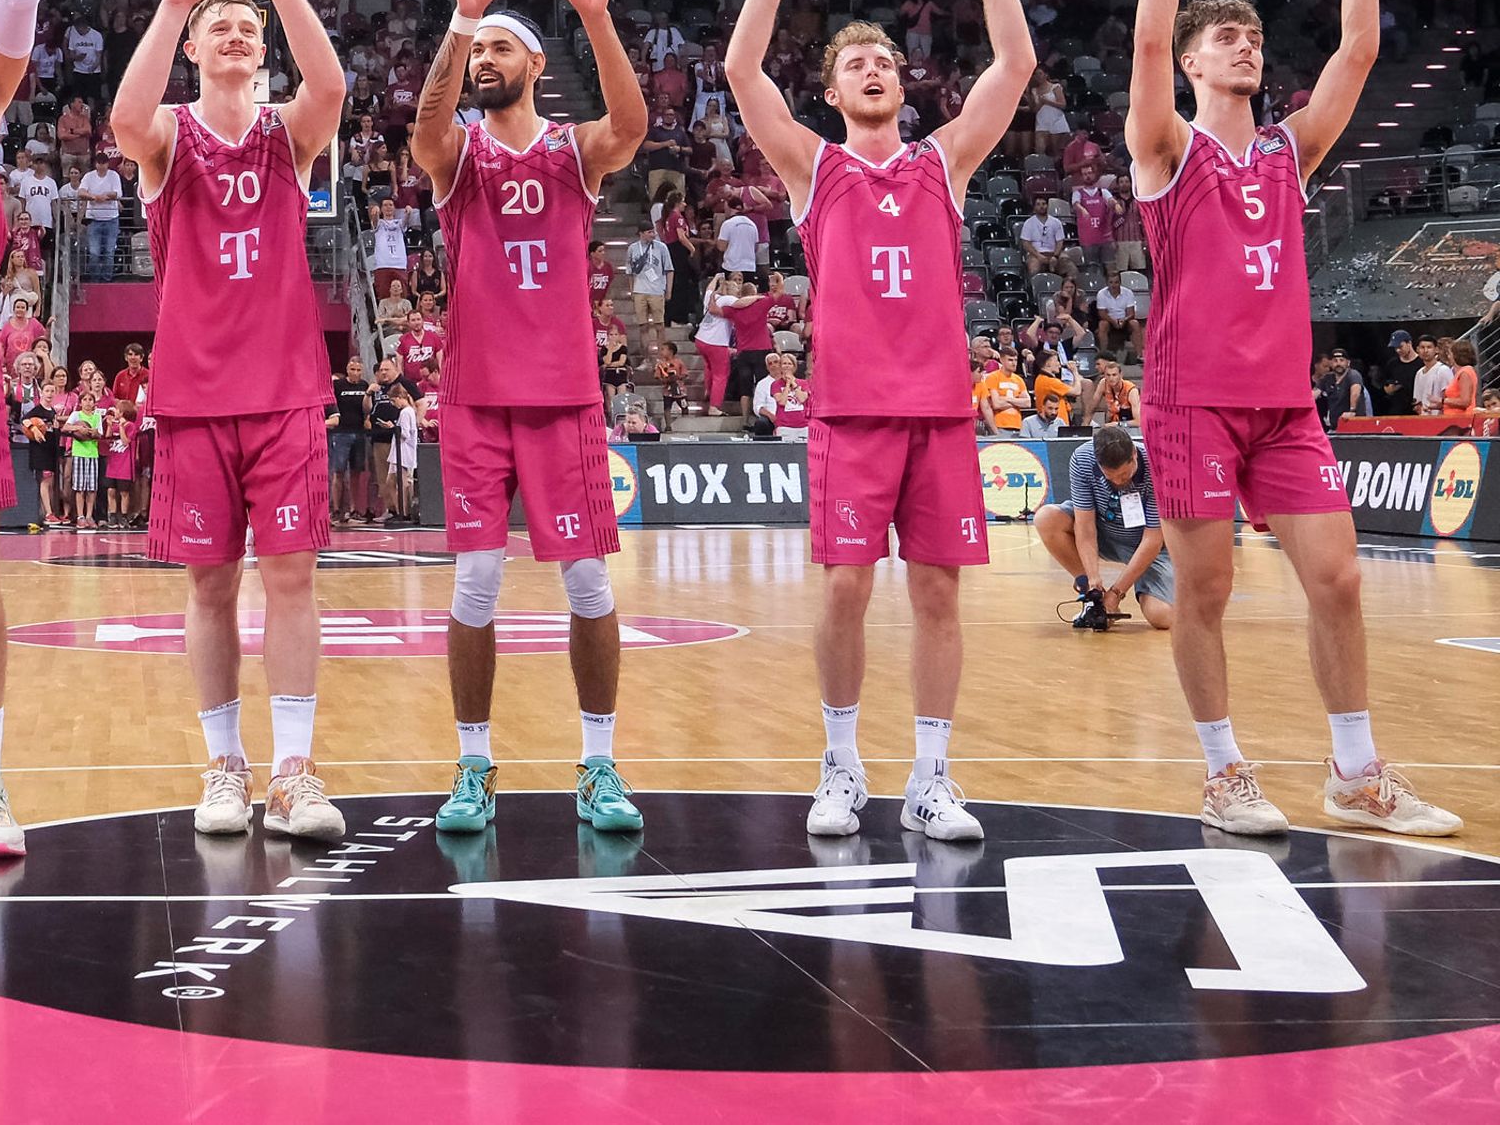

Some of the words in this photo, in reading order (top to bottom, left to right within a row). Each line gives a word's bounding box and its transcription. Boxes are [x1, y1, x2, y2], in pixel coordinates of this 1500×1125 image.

[30, 187, 50, 197] GAP
[217, 170, 262, 207] 70
[501, 179, 545, 215] 20
[878, 193, 900, 217] 4
[1240, 184, 1267, 220] 5
[219, 227, 260, 280] T
[504, 240, 548, 290] T
[1243, 239, 1282, 291] T
[871, 246, 913, 298] T
[646, 463, 731, 505] 10X
[743, 463, 803, 504] IN
[1319, 465, 1341, 491] T
[1351, 461, 1432, 512] BONN
[1433, 469, 1474, 502] LIDL
[276, 504, 299, 532] T
[556, 512, 581, 540] T
[961, 517, 979, 544] T
[836, 536, 867, 546] SPALDING
